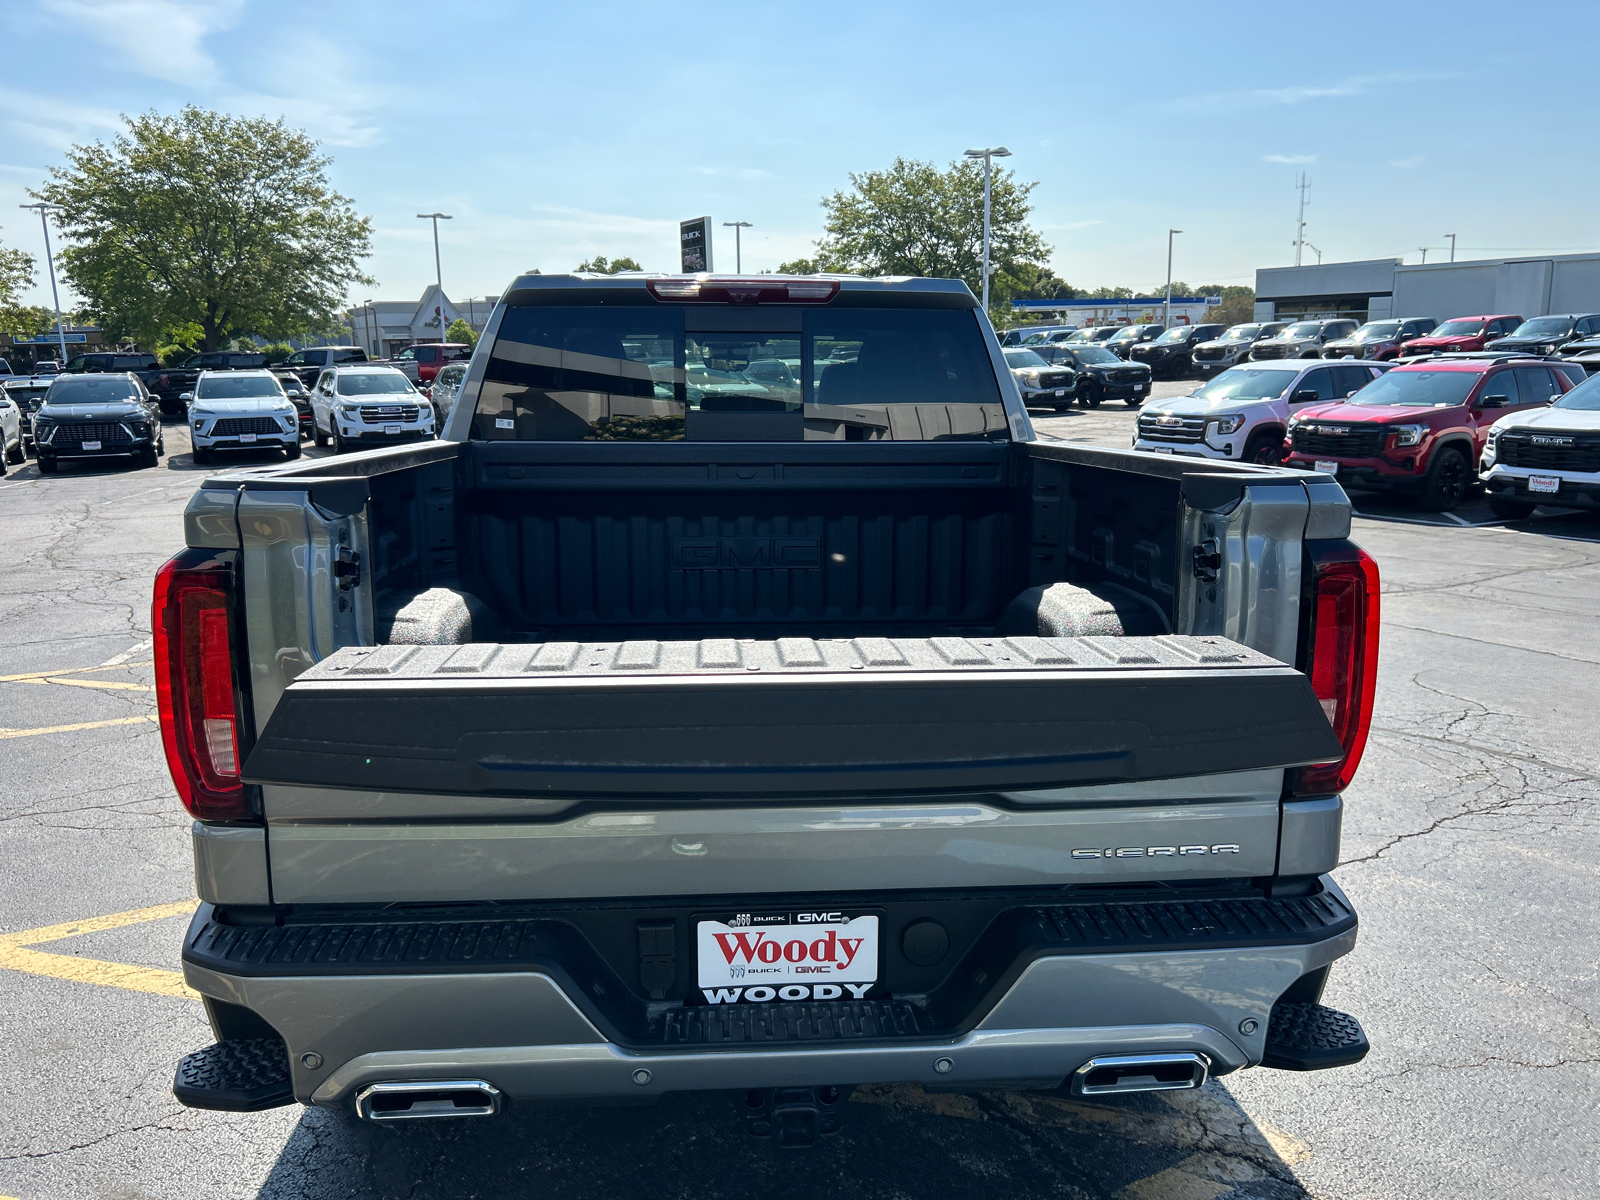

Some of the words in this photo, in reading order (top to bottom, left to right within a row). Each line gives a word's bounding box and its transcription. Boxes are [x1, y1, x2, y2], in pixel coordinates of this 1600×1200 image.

[682, 230, 700, 240] BUICK
[1532, 436, 1573, 447] GMC
[1532, 478, 1556, 487] Woody
[673, 539, 820, 568] GMC
[1071, 843, 1240, 860] SIERRA
[797, 912, 842, 923] GMC
[712, 930, 865, 970] Woody
[795, 965, 831, 974] GMC
[702, 983, 875, 1005] WOODY
